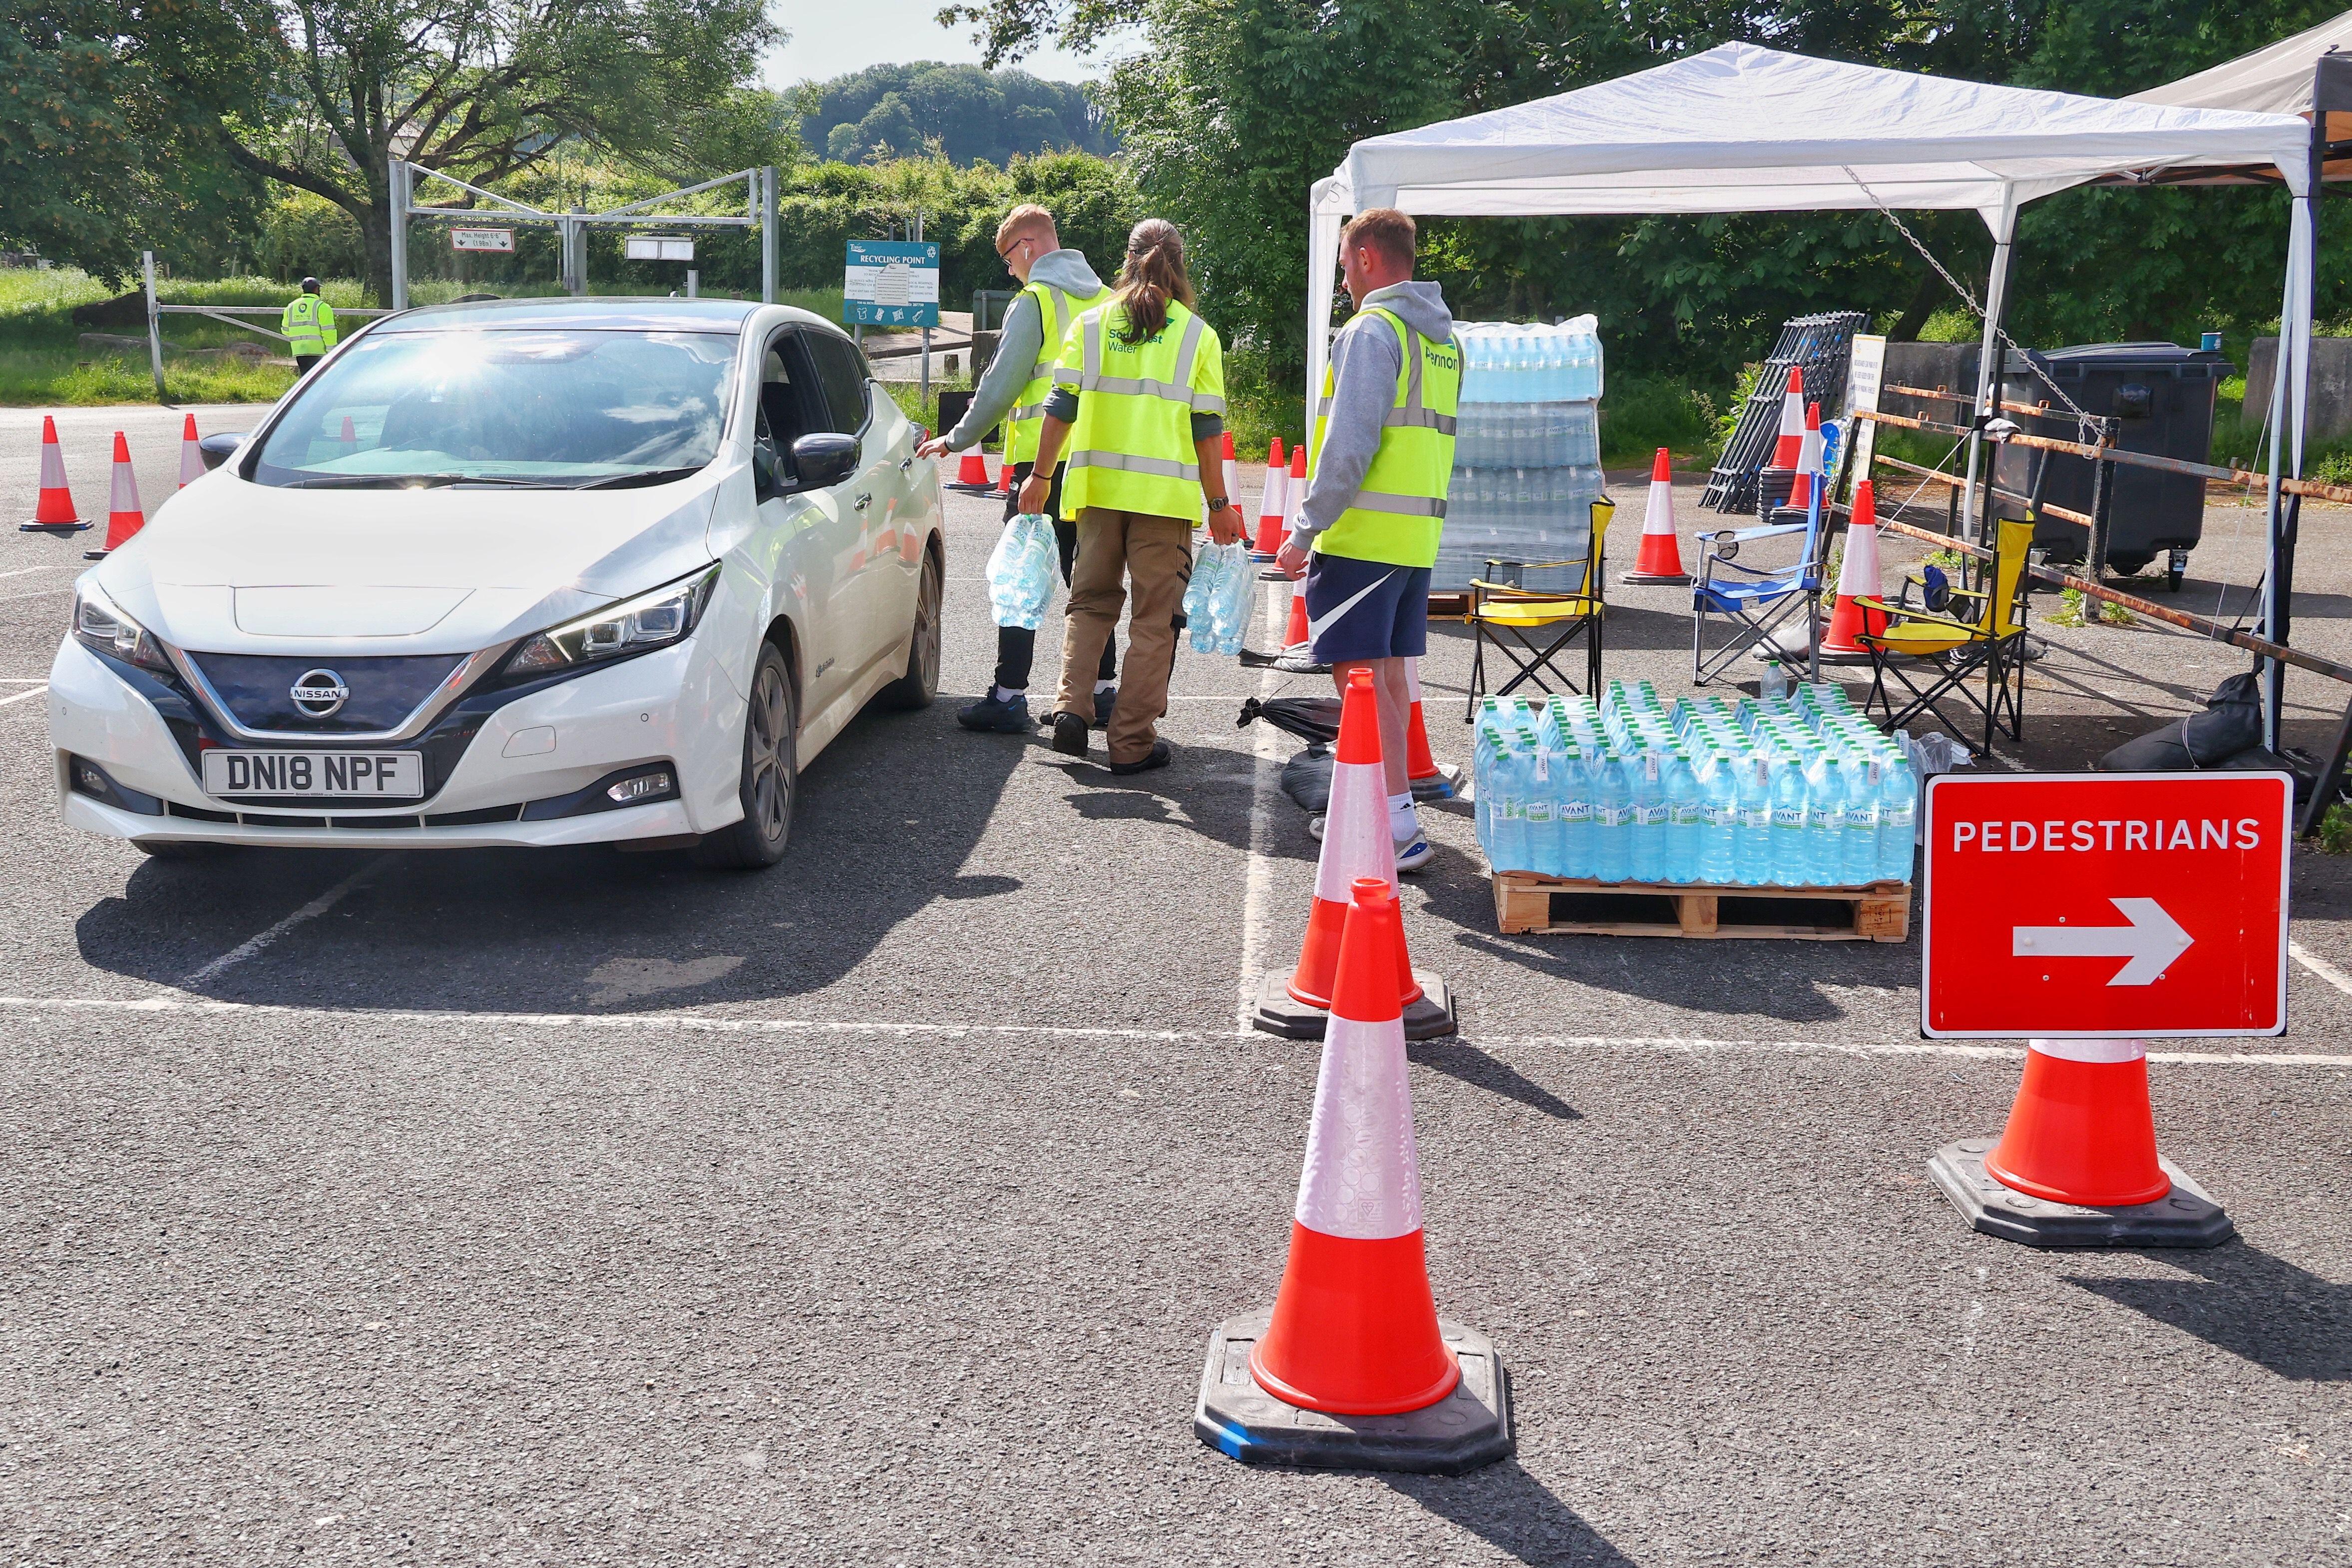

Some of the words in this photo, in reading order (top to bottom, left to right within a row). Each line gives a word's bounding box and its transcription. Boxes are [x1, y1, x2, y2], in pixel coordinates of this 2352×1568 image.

[860, 255, 900, 263] RECYCLING
[1108, 341, 1137, 354] Water
[1426, 346, 1458, 372] Pennon
[294, 690, 342, 699] NISSAN
[227, 755, 313, 790] DN18
[325, 756, 397, 791] NPF
[1561, 804, 1590, 815] AVANT
[1953, 817, 2260, 852] PEDESTRIANS
